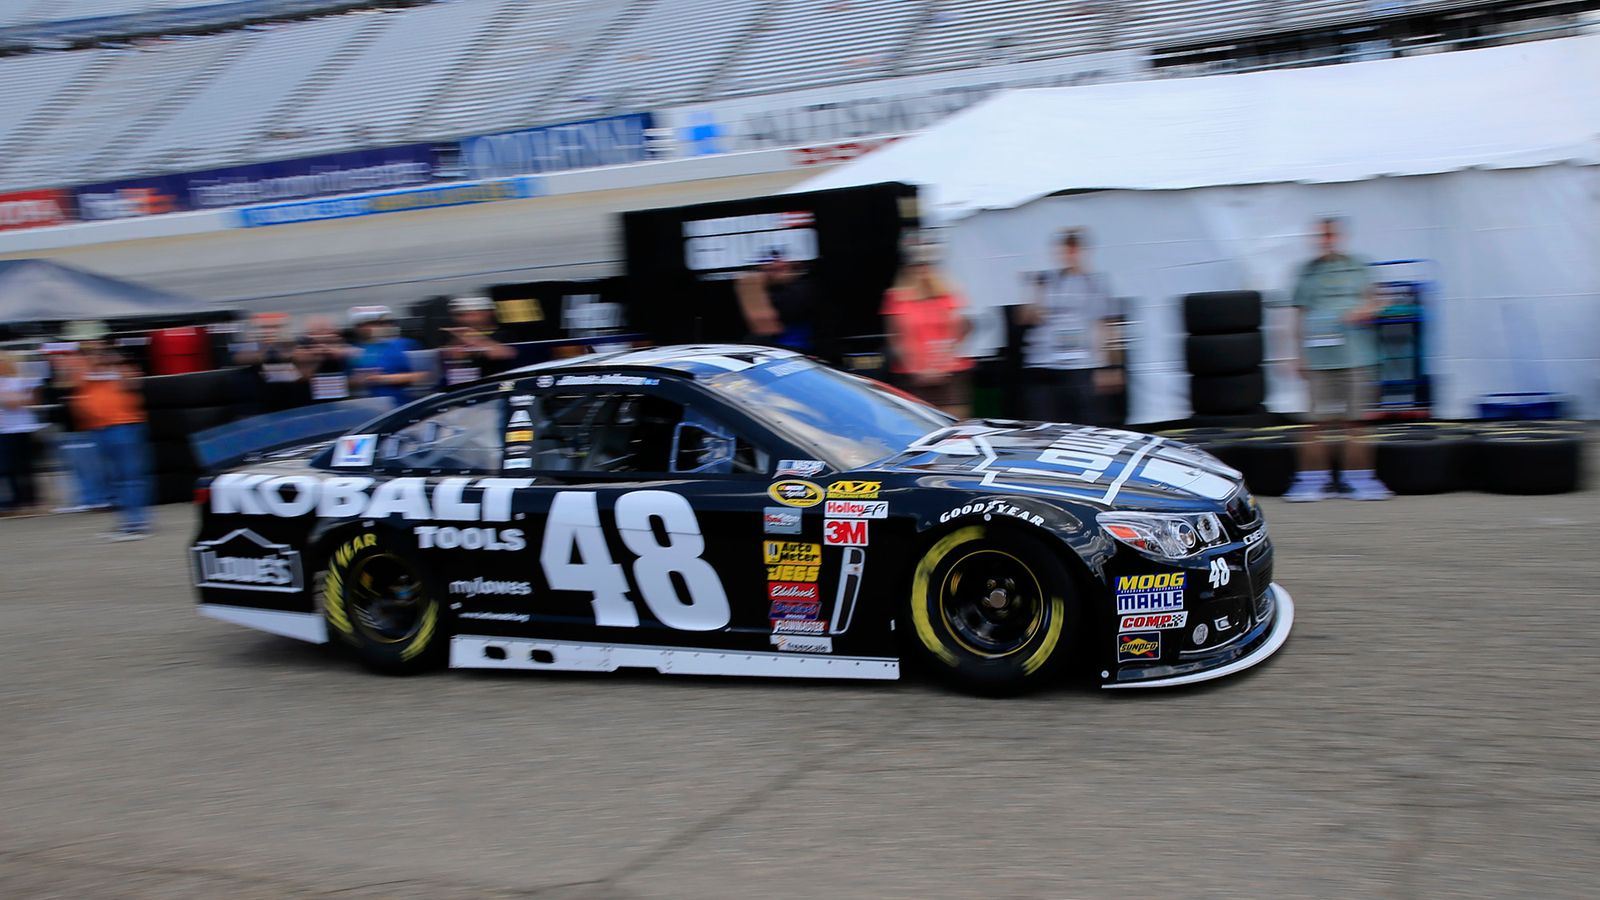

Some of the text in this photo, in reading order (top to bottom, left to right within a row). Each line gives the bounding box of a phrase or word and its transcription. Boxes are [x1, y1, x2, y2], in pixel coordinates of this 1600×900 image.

[209, 473, 536, 522] KOBALT
[827, 502, 865, 517] Holley
[940, 501, 1045, 527] GOODYEAR
[414, 526, 527, 551] TOOLS
[826, 521, 866, 545] 3M
[779, 552, 820, 563] Meter
[781, 543, 813, 553] Auto
[540, 490, 731, 631] 48
[767, 565, 821, 582] JEGS
[1118, 572, 1185, 591] MOOG
[1208, 557, 1230, 589] 48
[1118, 591, 1182, 610] MAHLE
[1122, 615, 1172, 628] COMP
